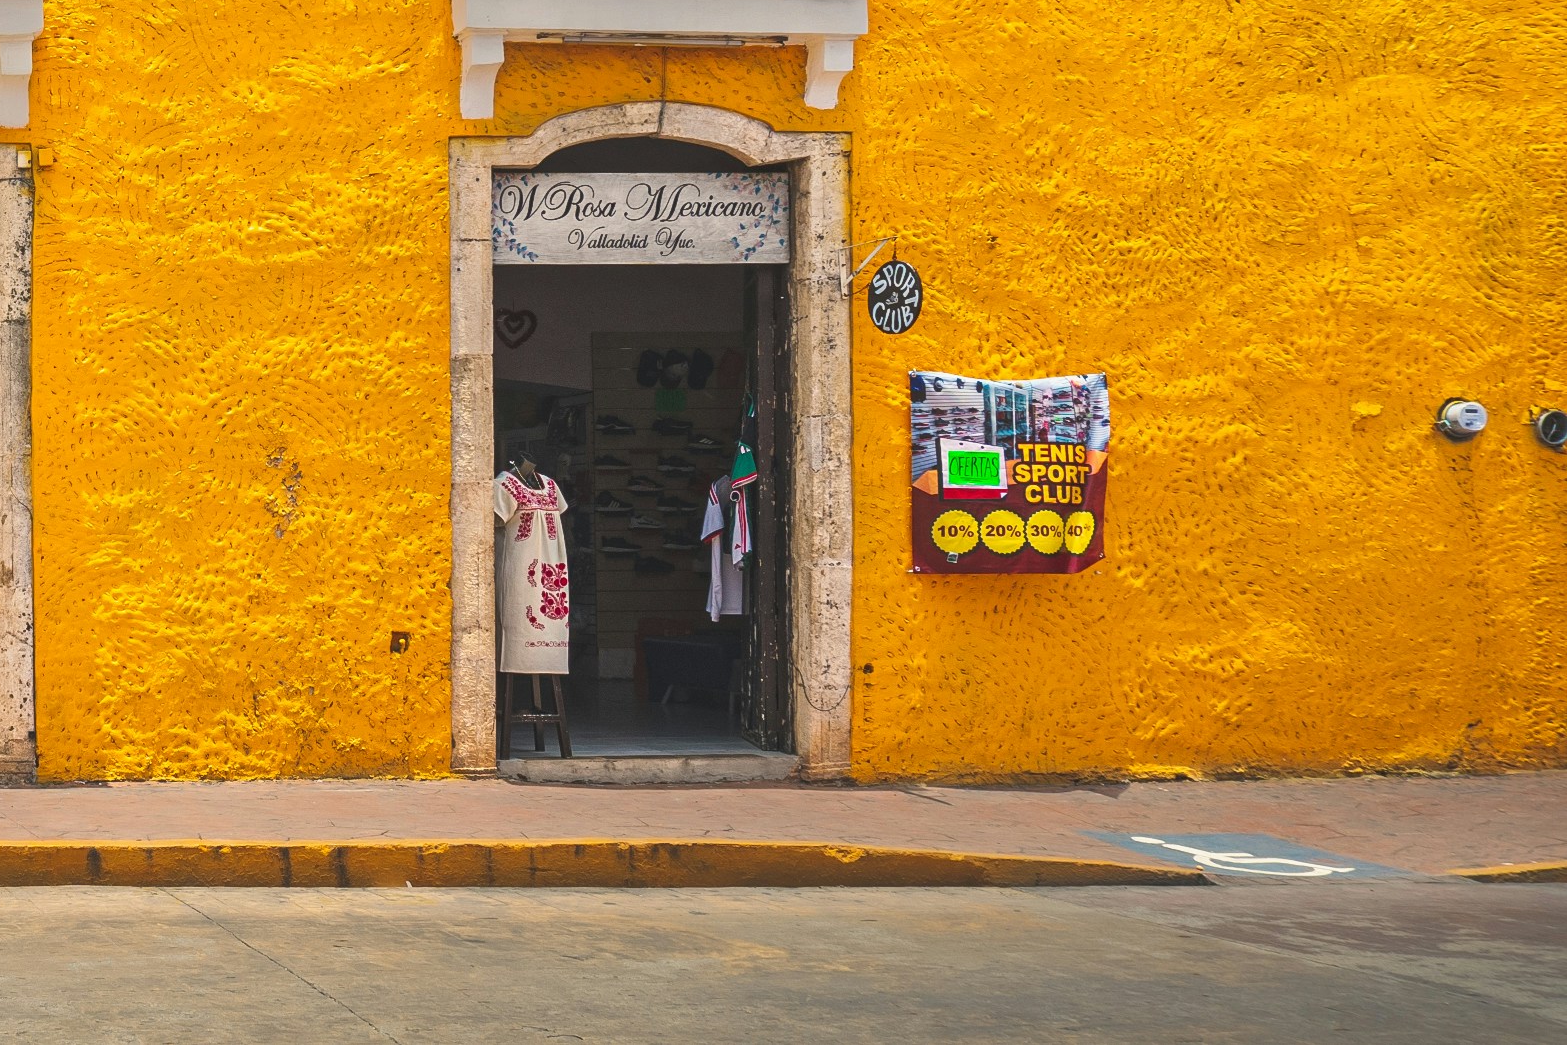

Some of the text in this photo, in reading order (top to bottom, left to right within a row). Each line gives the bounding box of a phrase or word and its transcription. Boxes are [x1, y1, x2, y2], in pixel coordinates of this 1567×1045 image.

[624, 183, 766, 222] Mexicano
[568, 226, 695, 256] Valladolid Yuc.
[872, 263, 919, 308] SPORT
[872, 301, 914, 334] CLUB
[1017, 443, 1085, 463] TENIS
[949, 456, 1000, 478] OFERTAS
[1015, 464, 1089, 484] SPORT
[1025, 484, 1082, 504] CLUB
[937, 525, 975, 538] 10%
[985, 525, 1022, 538] 20%
[1031, 525, 1062, 538] 30%
